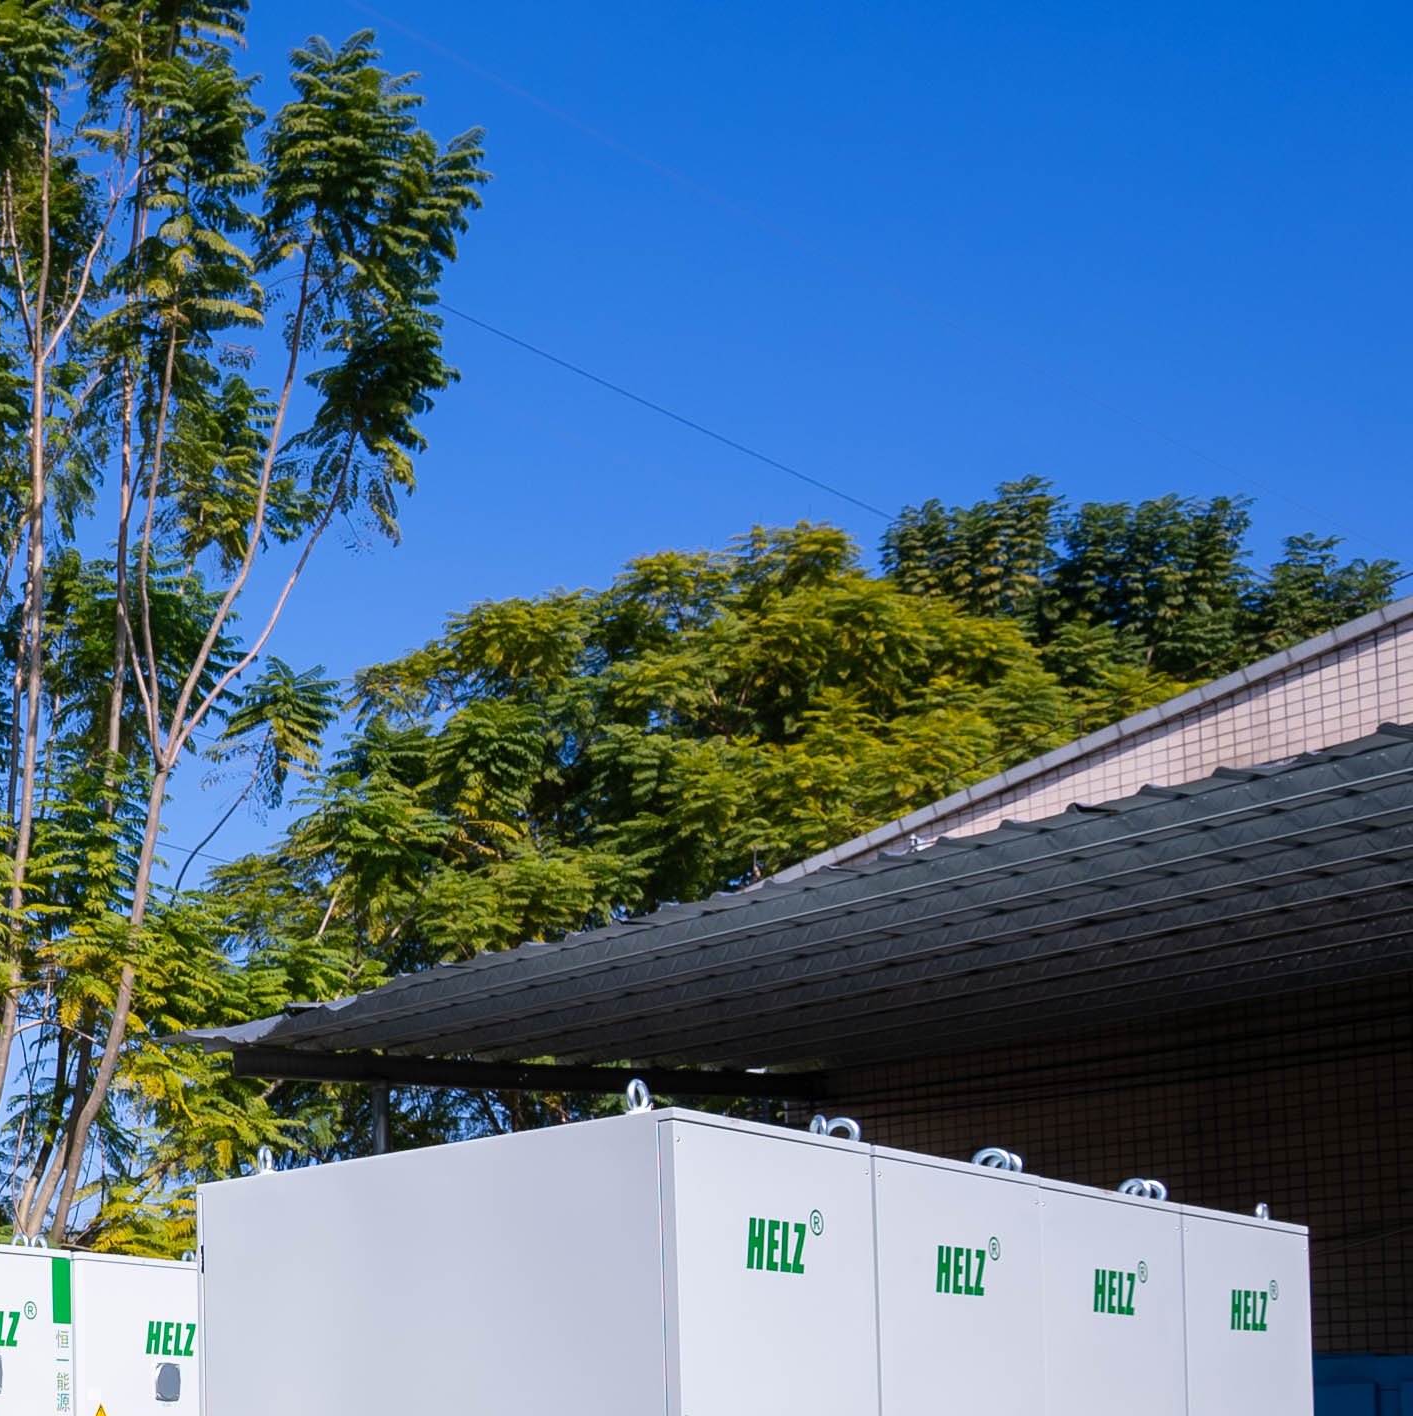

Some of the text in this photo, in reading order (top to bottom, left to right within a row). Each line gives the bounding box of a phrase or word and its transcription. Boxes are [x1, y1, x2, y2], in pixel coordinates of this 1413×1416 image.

[746, 1217, 807, 1275] HELZ
[936, 1245, 986, 1297] HELZ
[1093, 1267, 1136, 1316] HELZ
[1230, 1289, 1268, 1332] HELZ
[146, 1320, 196, 1357] HELZ
